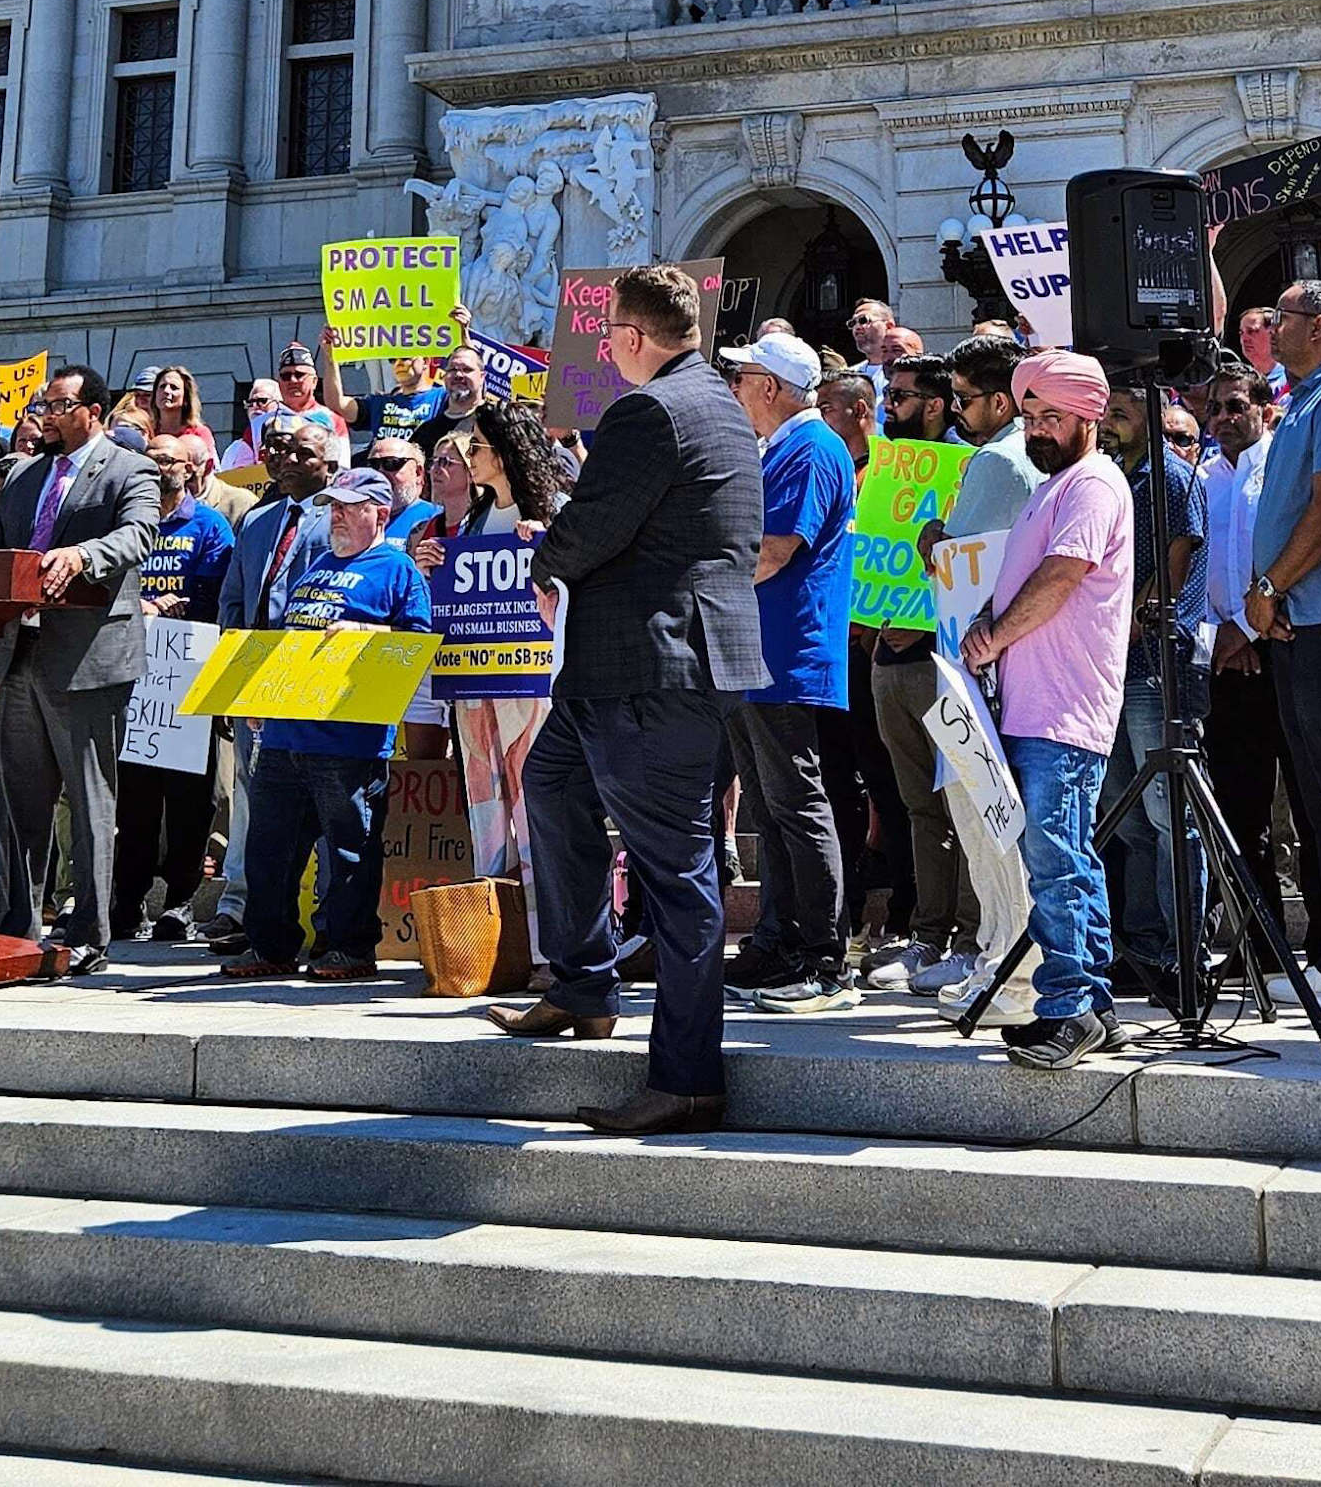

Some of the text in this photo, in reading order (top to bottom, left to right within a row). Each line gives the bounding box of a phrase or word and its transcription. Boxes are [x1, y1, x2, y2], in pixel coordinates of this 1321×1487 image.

[1267, 139, 1321, 175] DEPEND
[329, 246, 456, 271] PROTECT
[333, 284, 434, 311] SMALL
[332, 325, 452, 348] BUSINESS
[873, 441, 938, 484] PRO
[454, 548, 535, 593] STOP
[433, 605, 451, 617] THE
[453, 602, 493, 615] LARGEST
[494, 602, 512, 614] TAX
[450, 619, 541, 635] ON SMALL BUSINESS
[498, 651, 512, 662] on
[514, 648, 531, 664] SB
[533, 649, 553, 666] 756
[429, 823, 466, 860] Fire
